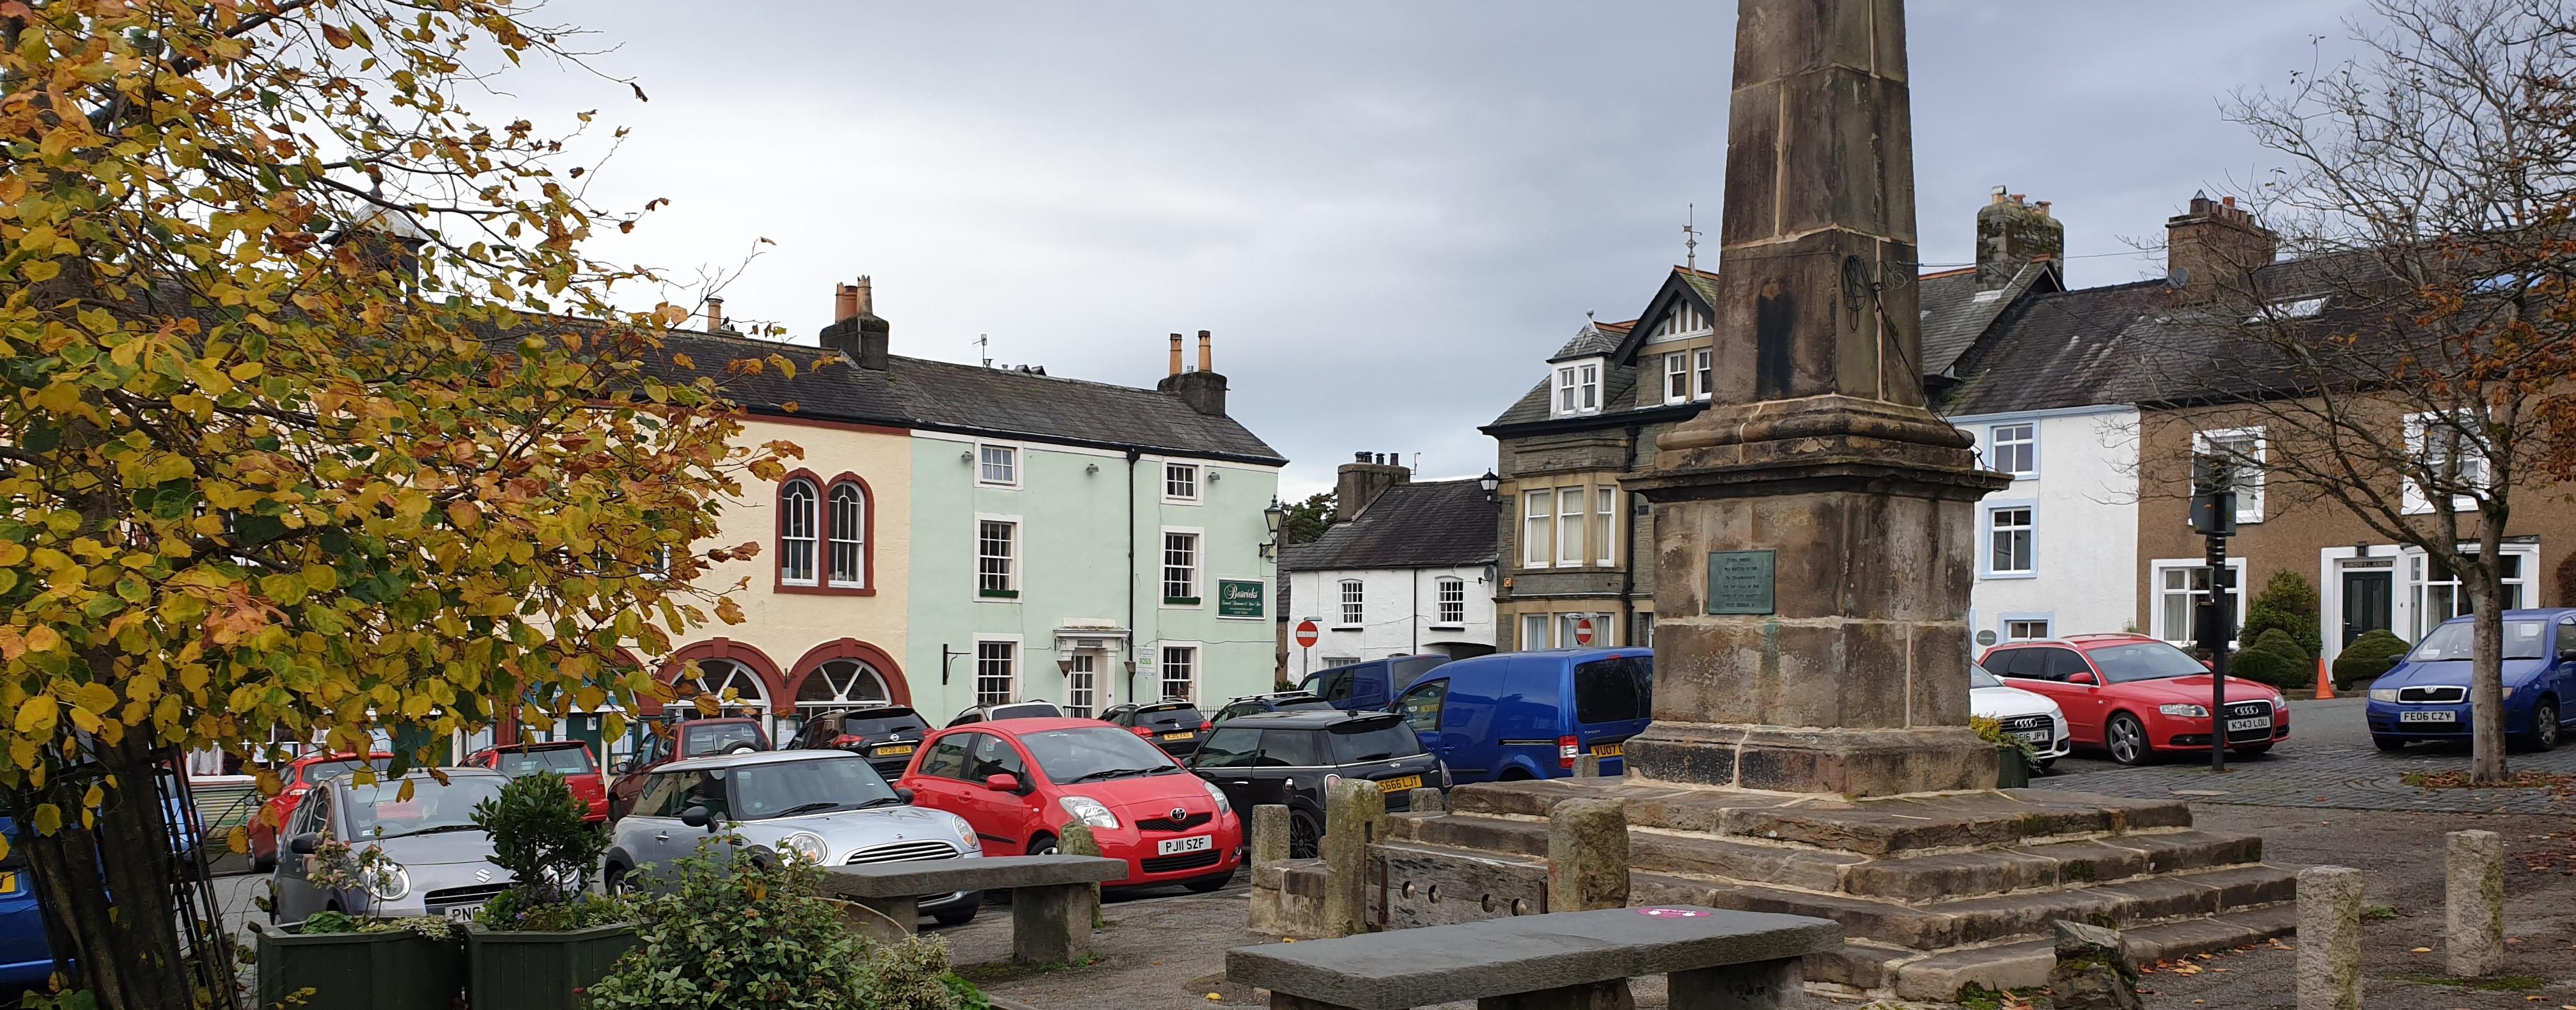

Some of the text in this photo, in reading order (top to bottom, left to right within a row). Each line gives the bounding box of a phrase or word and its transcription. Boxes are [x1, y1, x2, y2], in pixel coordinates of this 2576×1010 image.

[2405, 712, 2451, 720] FE06 CZY
[2232, 718, 2267, 729] K343 LOU
[2033, 731, 2045, 740] JPV
[1595, 745, 1616, 755] VU07
[1380, 777, 1418, 791] S666 LJT
[1166, 838, 1205, 853] PJ11 SZF
